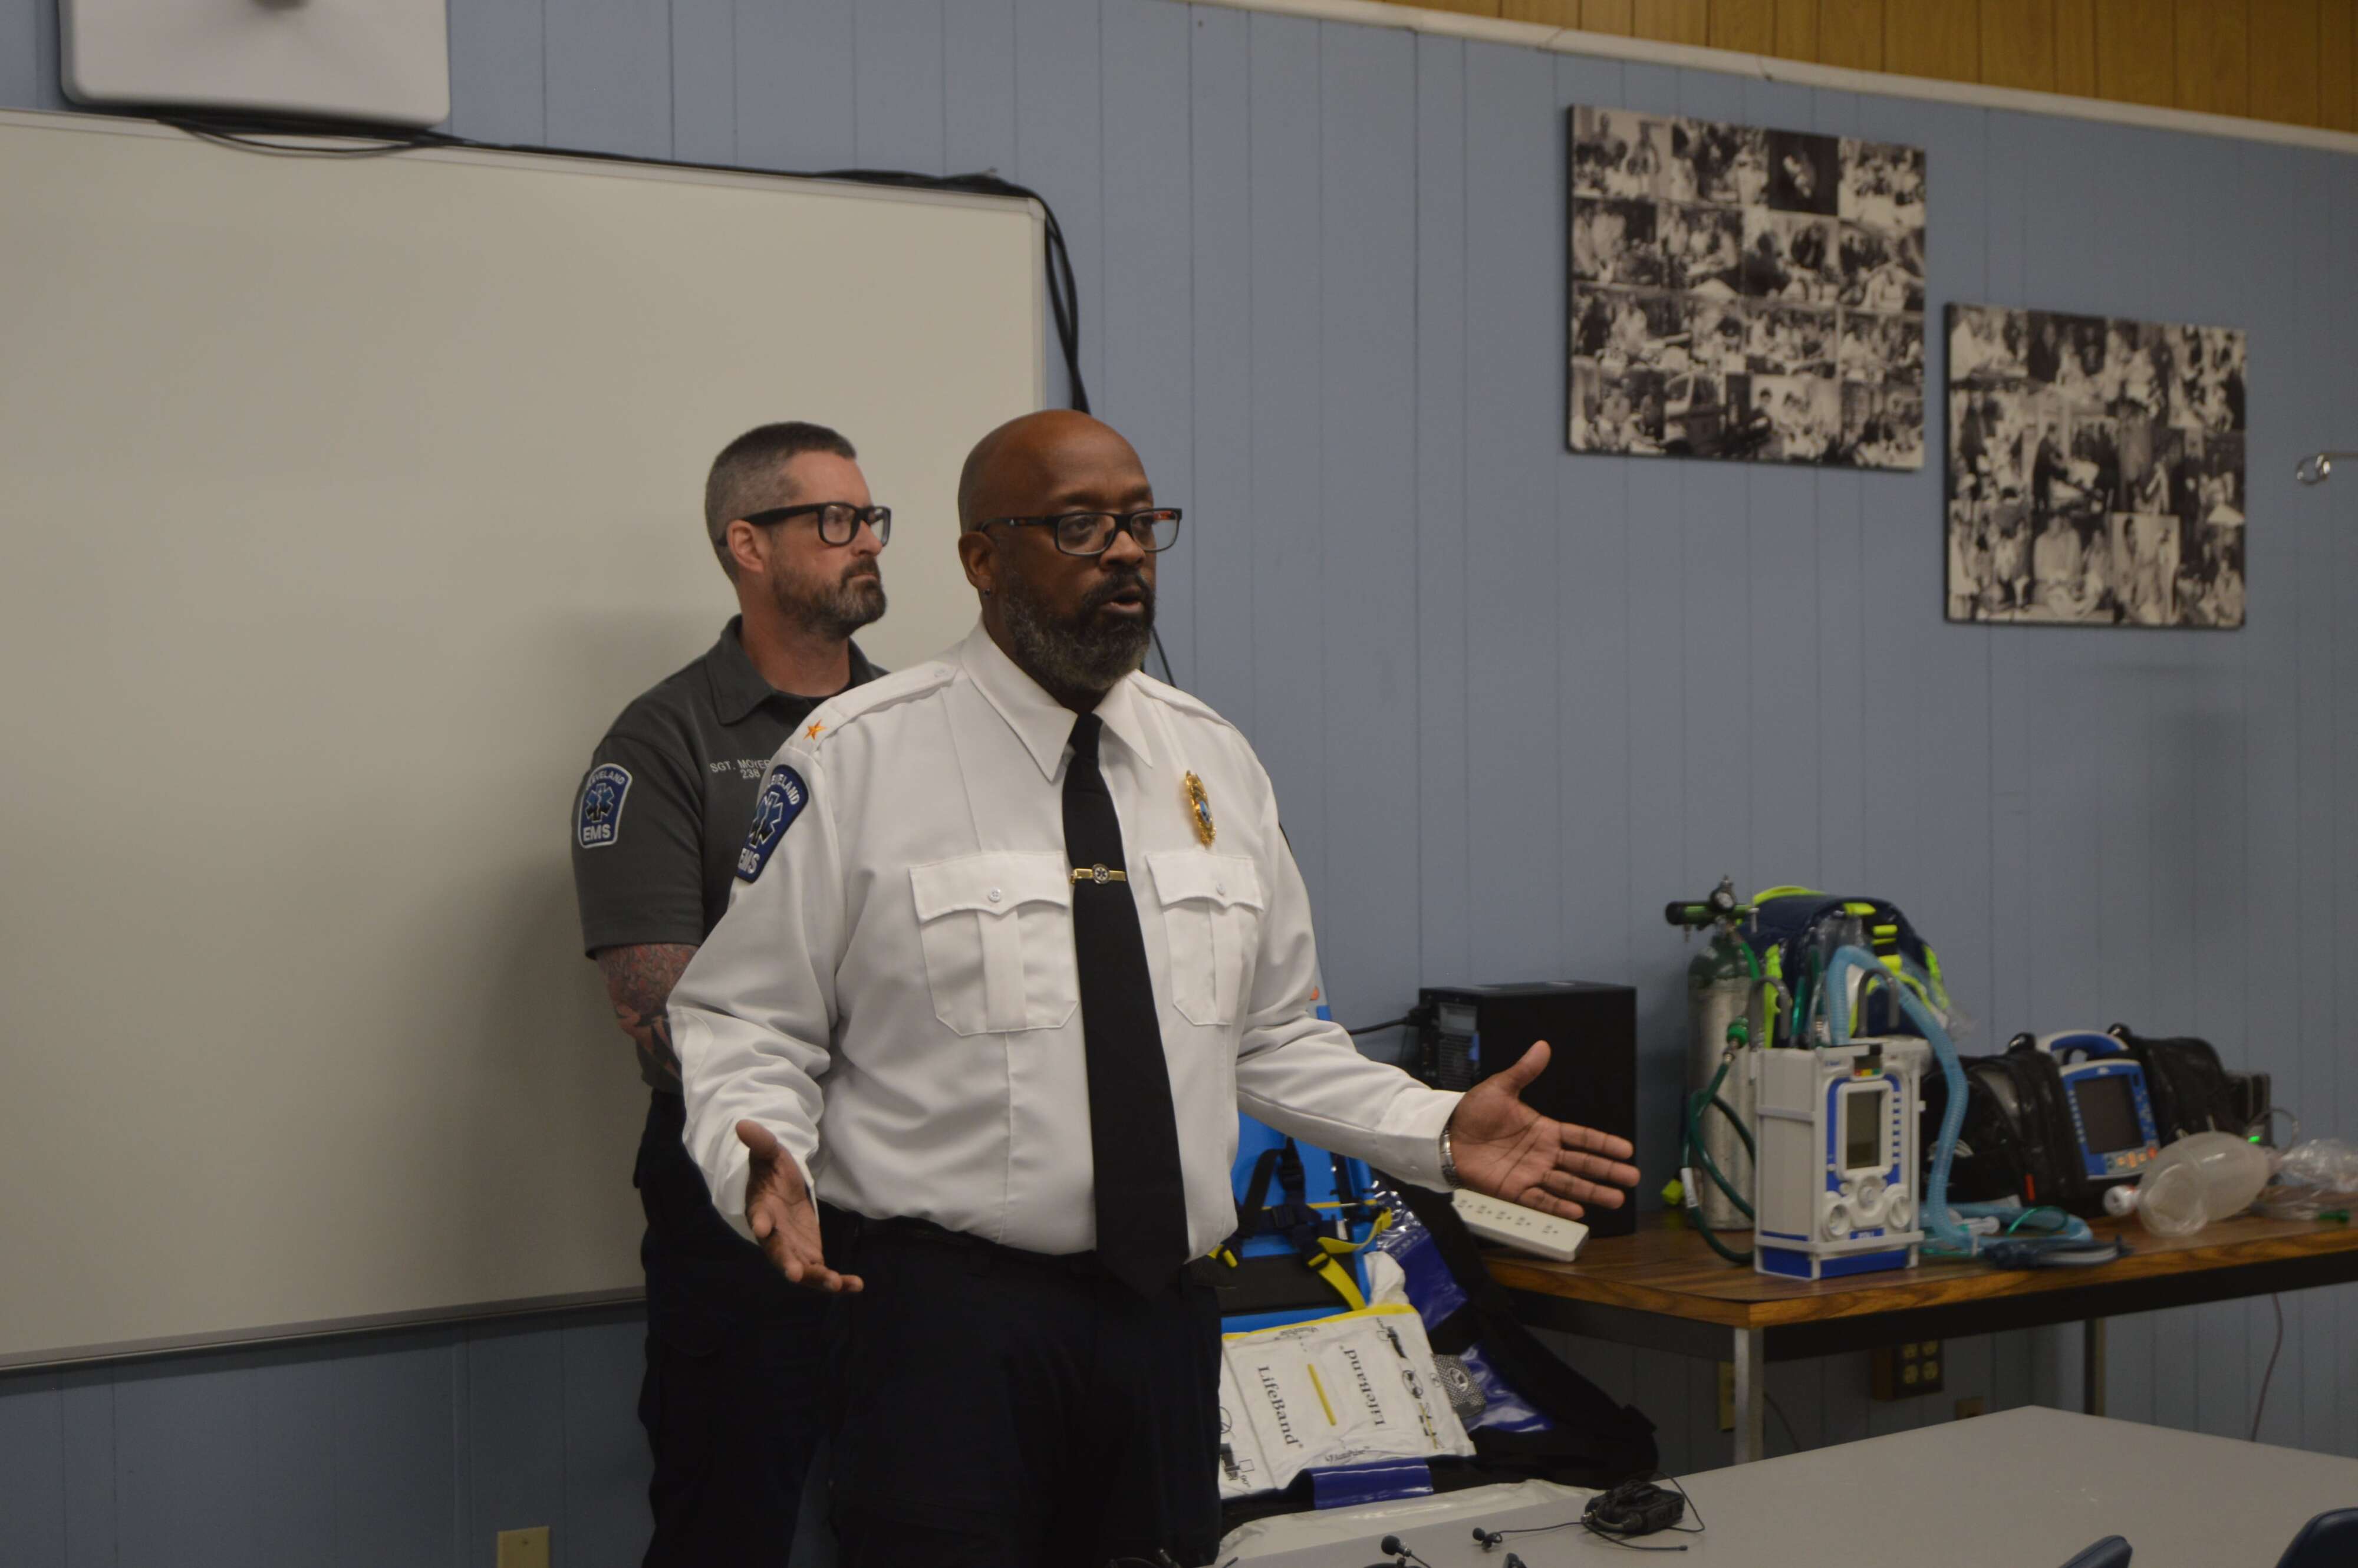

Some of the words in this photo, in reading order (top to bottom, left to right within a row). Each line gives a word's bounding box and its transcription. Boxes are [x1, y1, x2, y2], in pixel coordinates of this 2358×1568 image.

[710, 761, 736, 773] SGT.
[740, 769, 760, 779] 238
[583, 824, 611, 841] EMS
[737, 848, 760, 874] EMS
